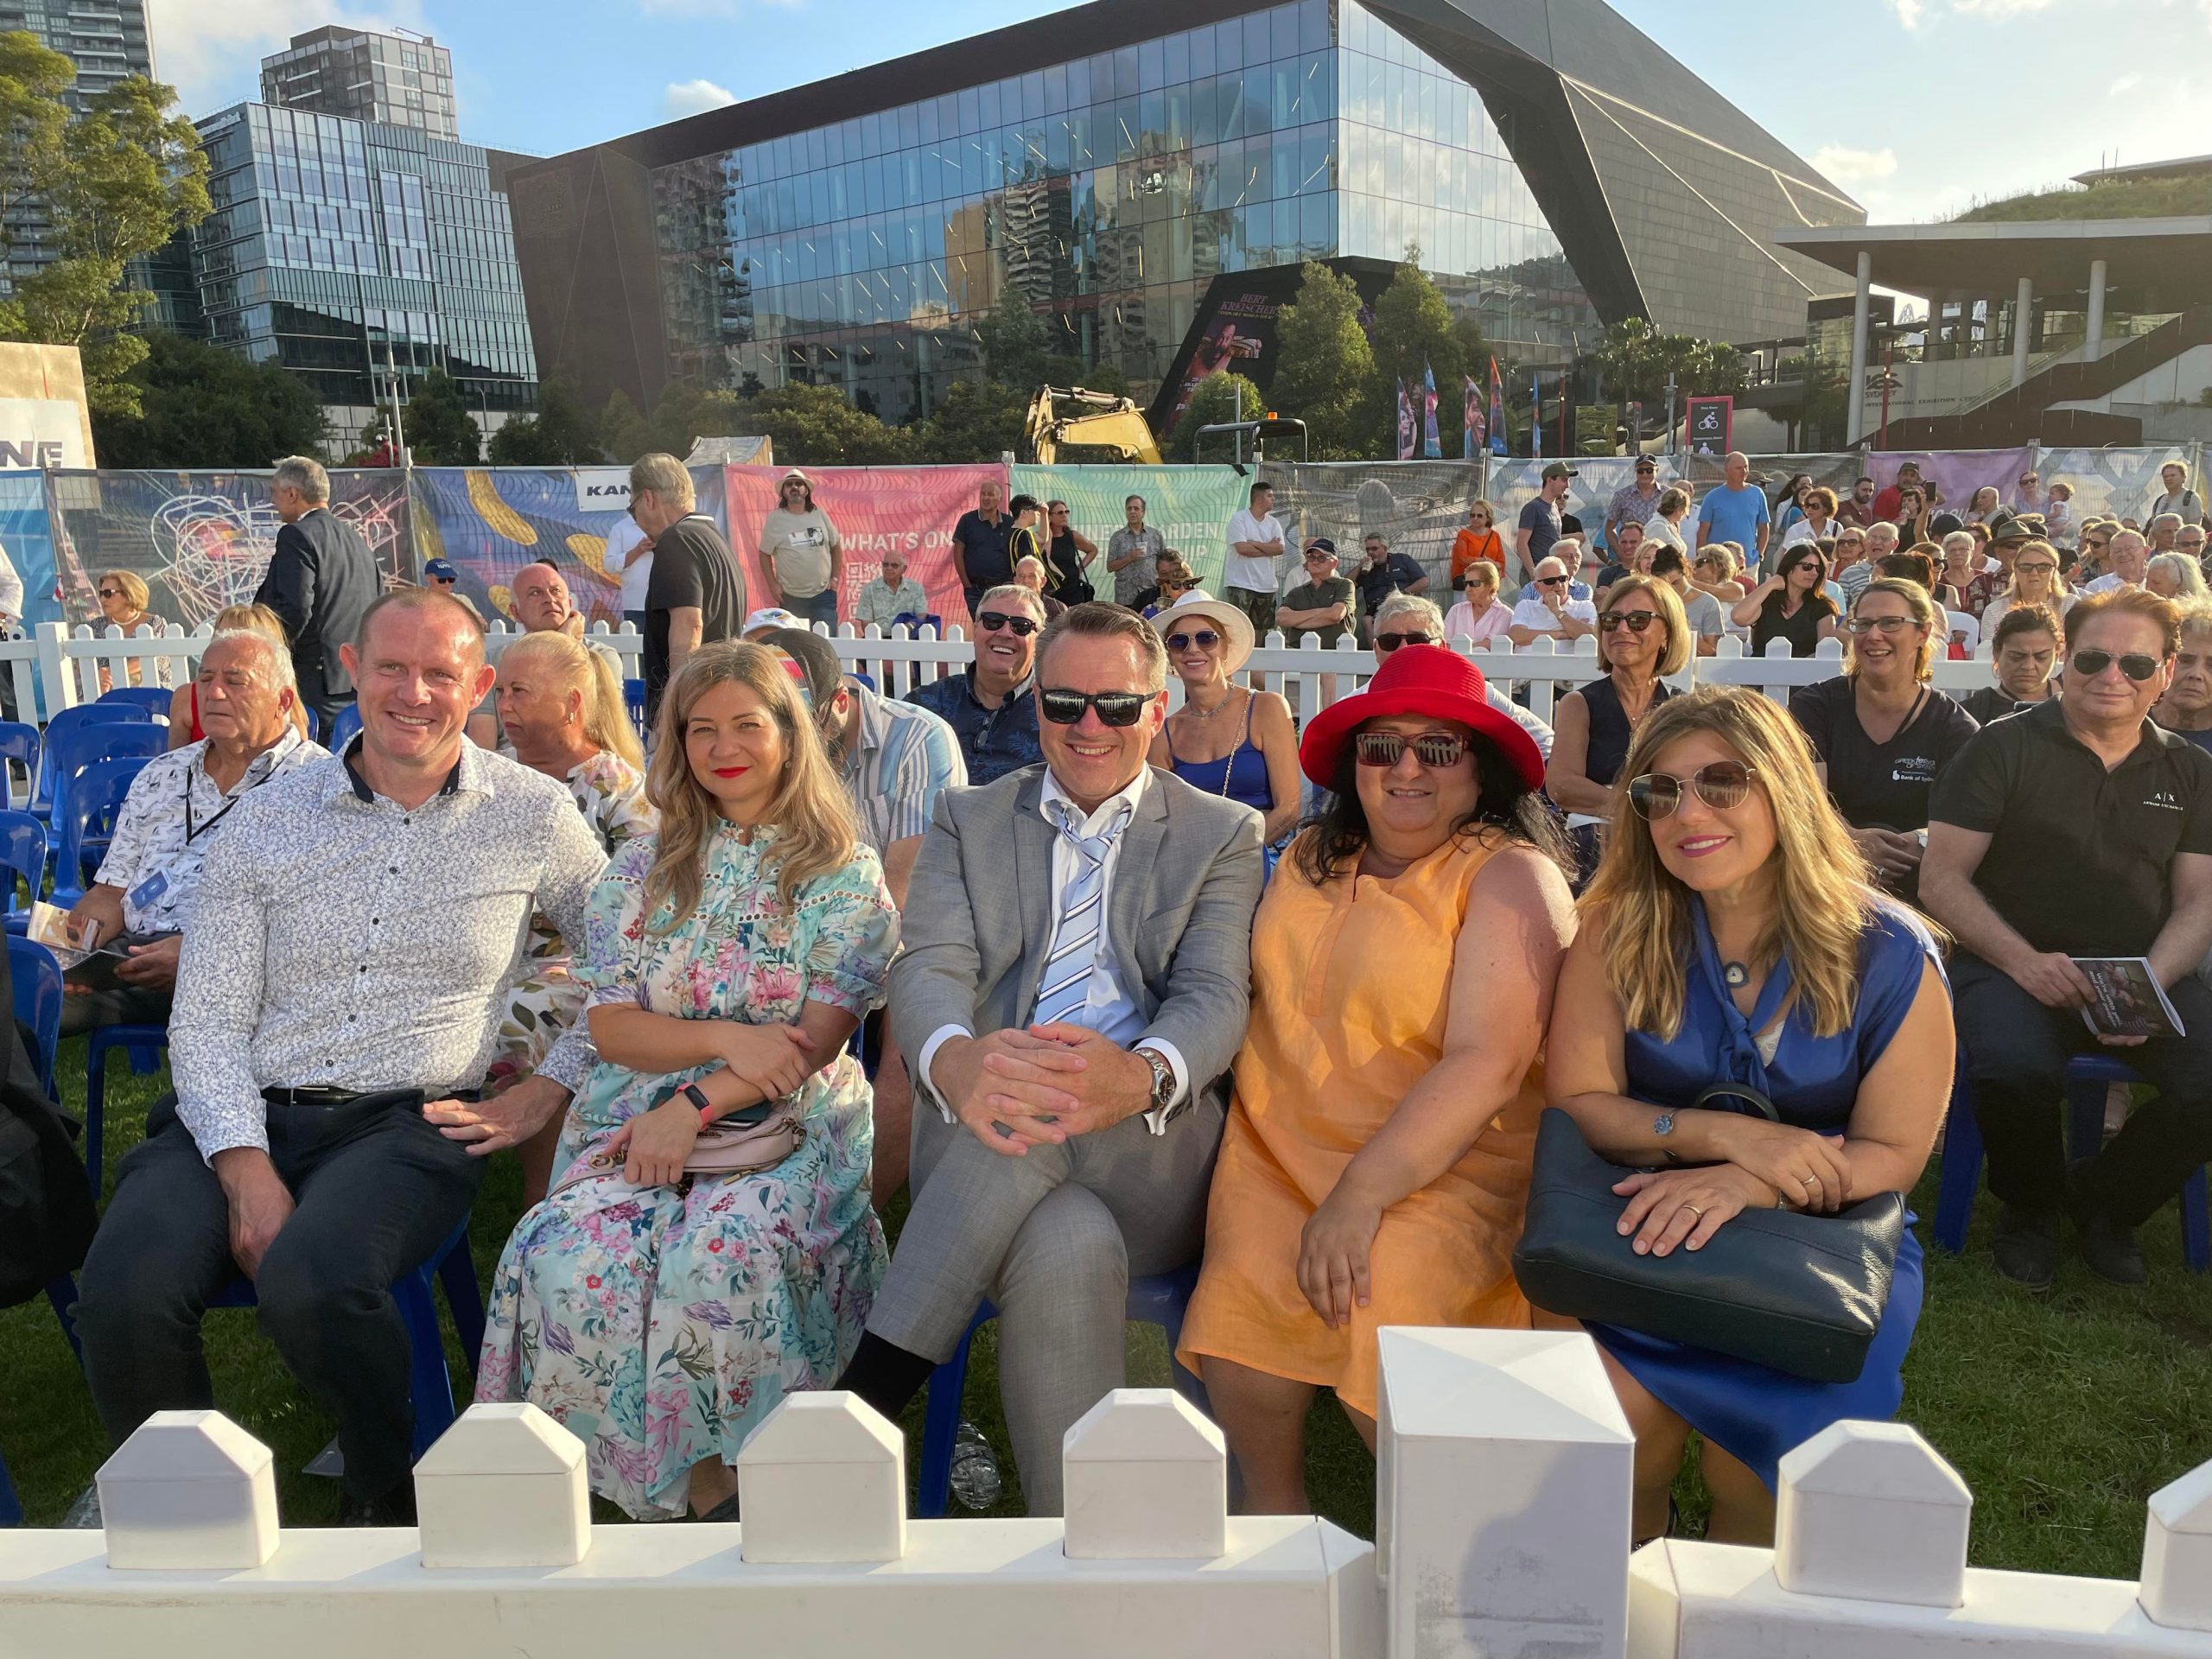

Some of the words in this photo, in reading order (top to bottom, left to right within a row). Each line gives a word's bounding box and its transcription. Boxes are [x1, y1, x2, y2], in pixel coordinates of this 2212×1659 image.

[1865, 399, 1914, 408] INTERATIONAL
[587, 485, 632, 496] KAN
[839, 531, 919, 551] WHAT'S
[924, 529, 955, 549] ON
